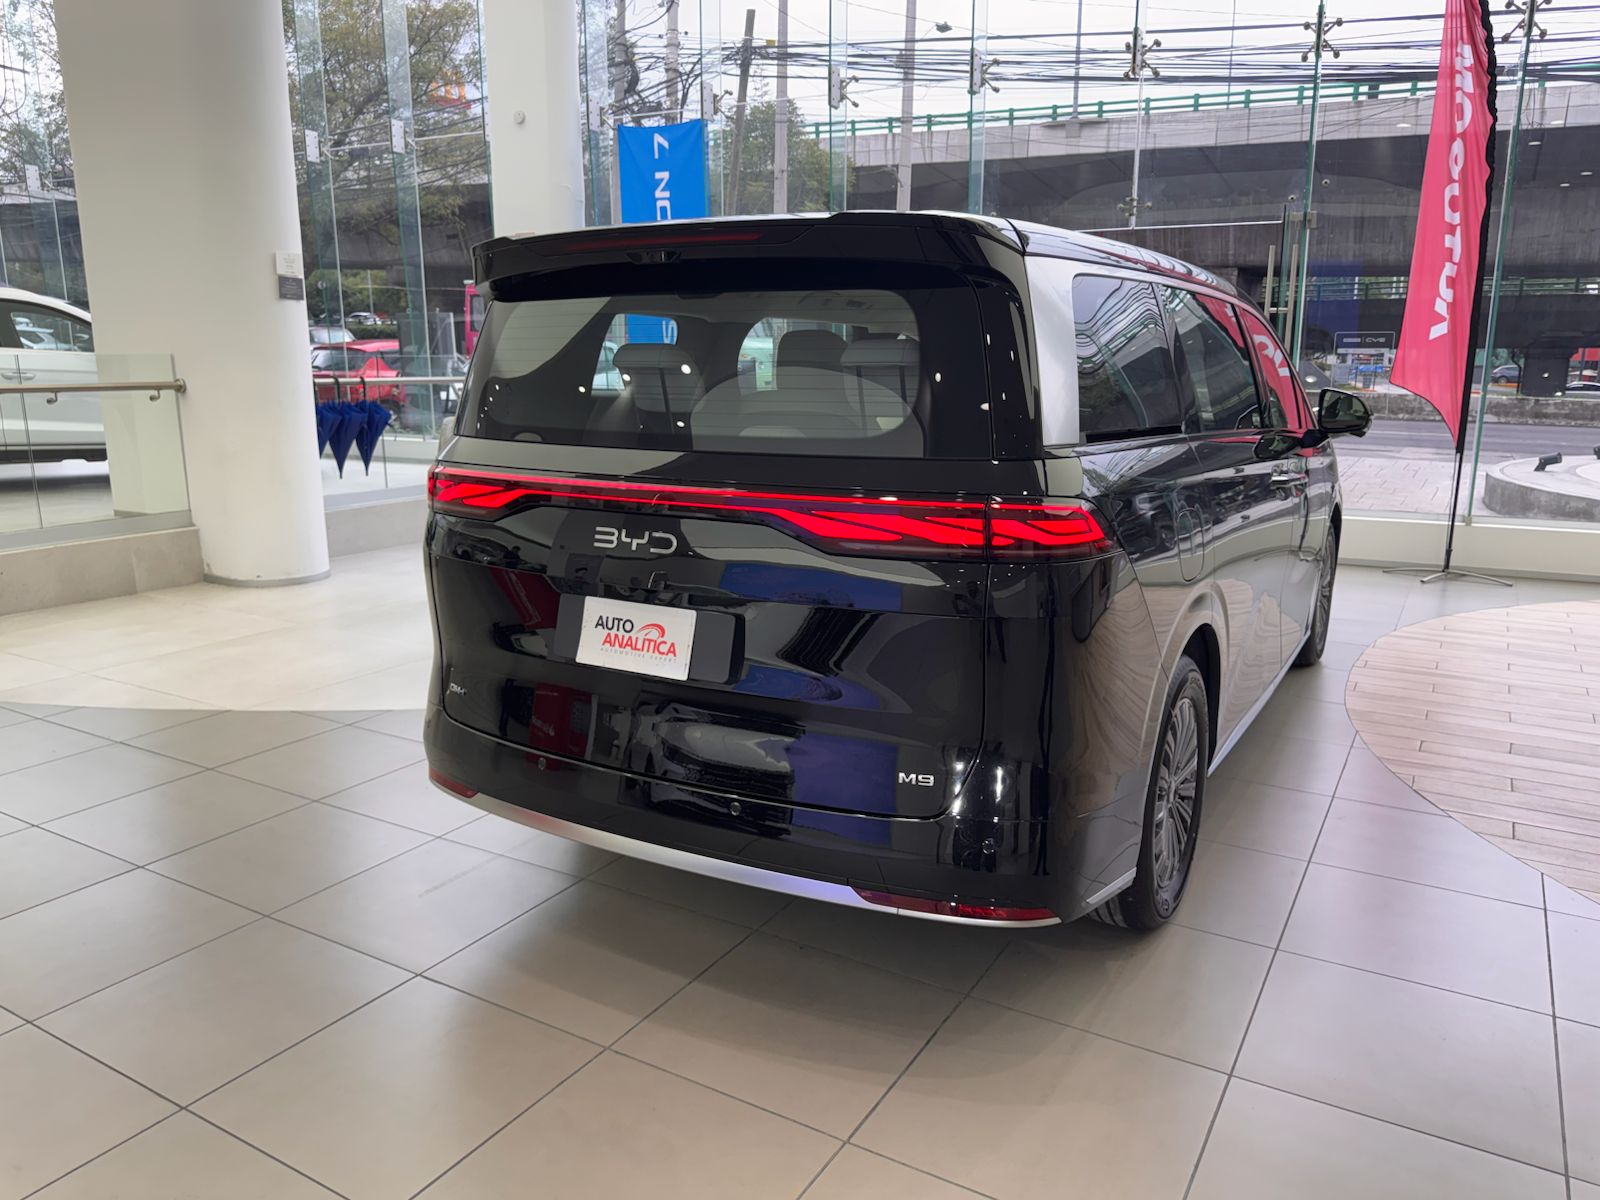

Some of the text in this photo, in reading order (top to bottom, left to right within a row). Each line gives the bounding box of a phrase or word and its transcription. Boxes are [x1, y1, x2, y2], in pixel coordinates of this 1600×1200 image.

[653, 132, 672, 221] ON 7
[593, 526, 678, 554] BYD
[594, 615, 634, 633] AUTO
[898, 771, 935, 787] M9
